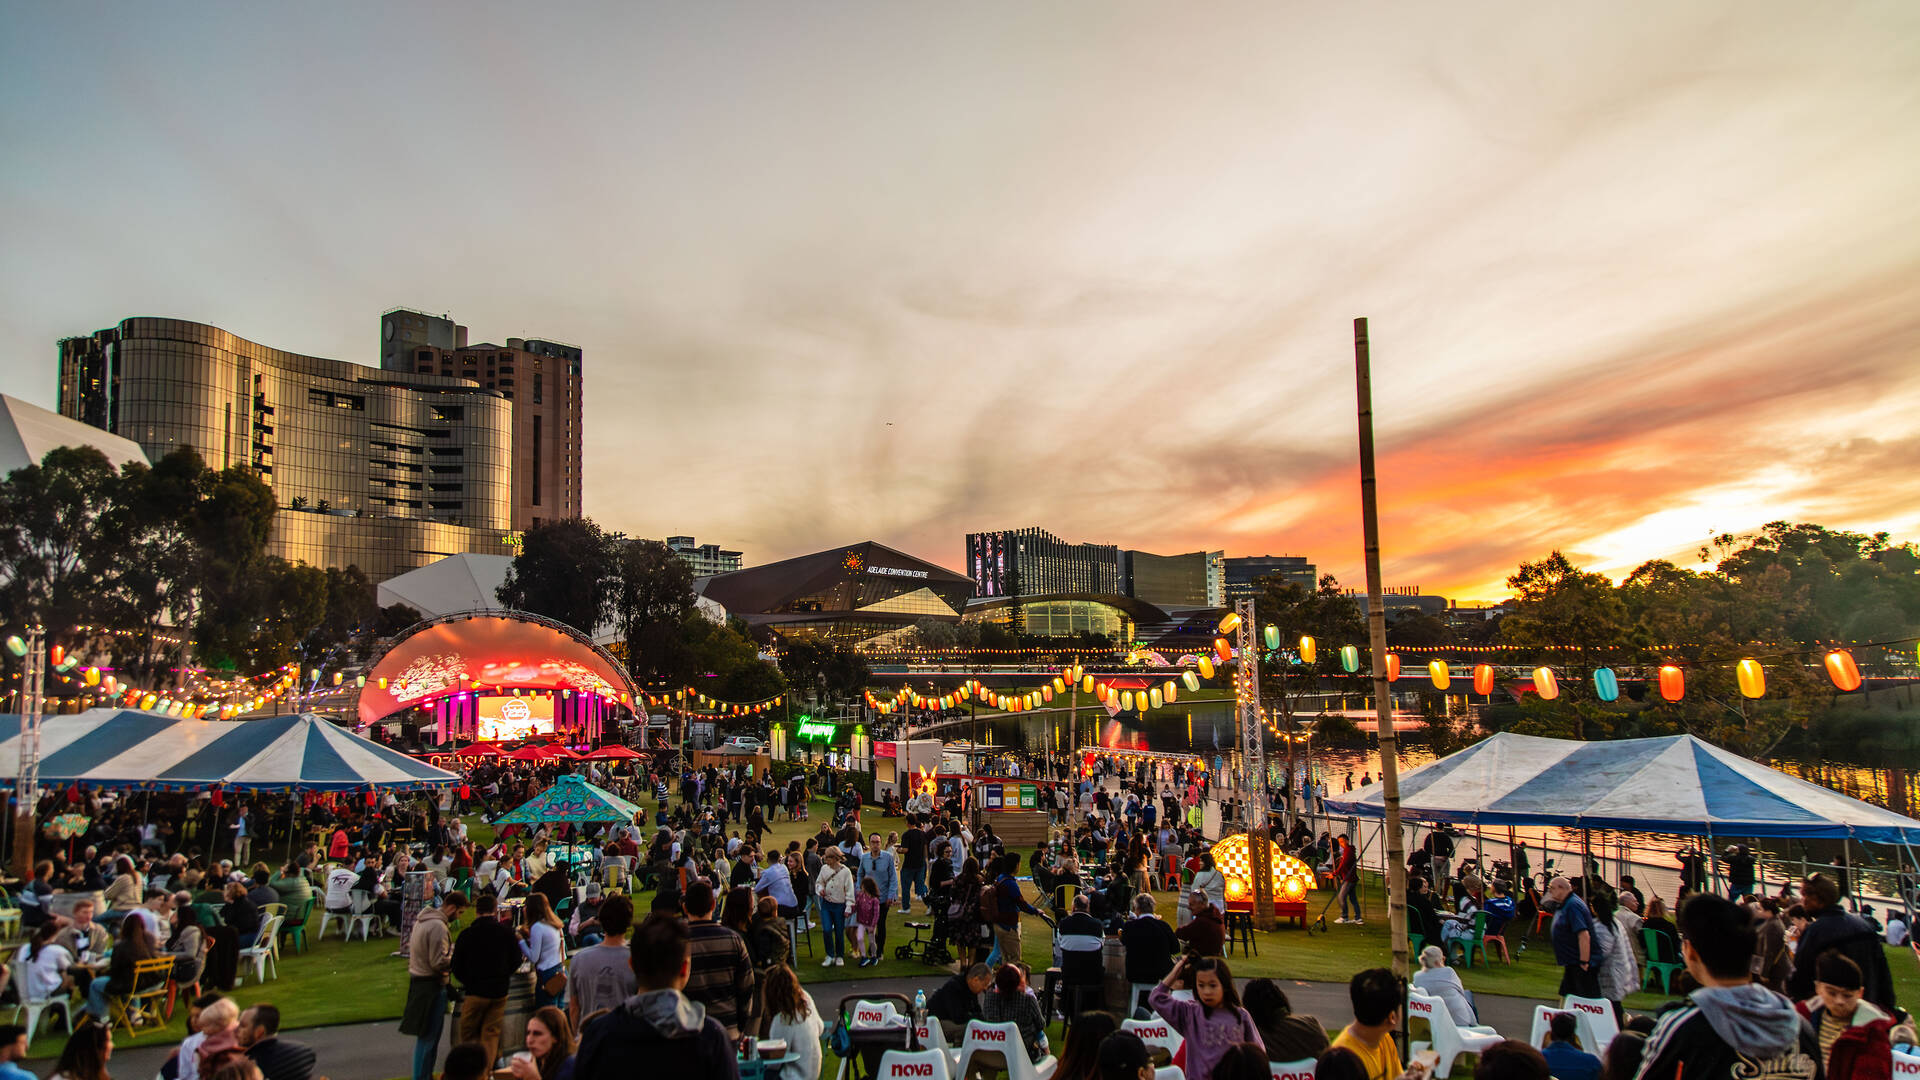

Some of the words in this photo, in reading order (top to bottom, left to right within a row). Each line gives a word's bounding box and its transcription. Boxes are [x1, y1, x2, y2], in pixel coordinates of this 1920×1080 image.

[867, 565, 888, 575] ADELAIDE
[887, 567, 912, 577] CONVENTION
[912, 570, 929, 578] CENTRE
[1409, 1001, 1432, 1013] nova
[857, 1011, 882, 1022] nova
[915, 1027, 929, 1038] va
[971, 1028, 1006, 1041] nova
[1134, 1027, 1168, 1039] nova
[891, 1063, 933, 1077] nova
